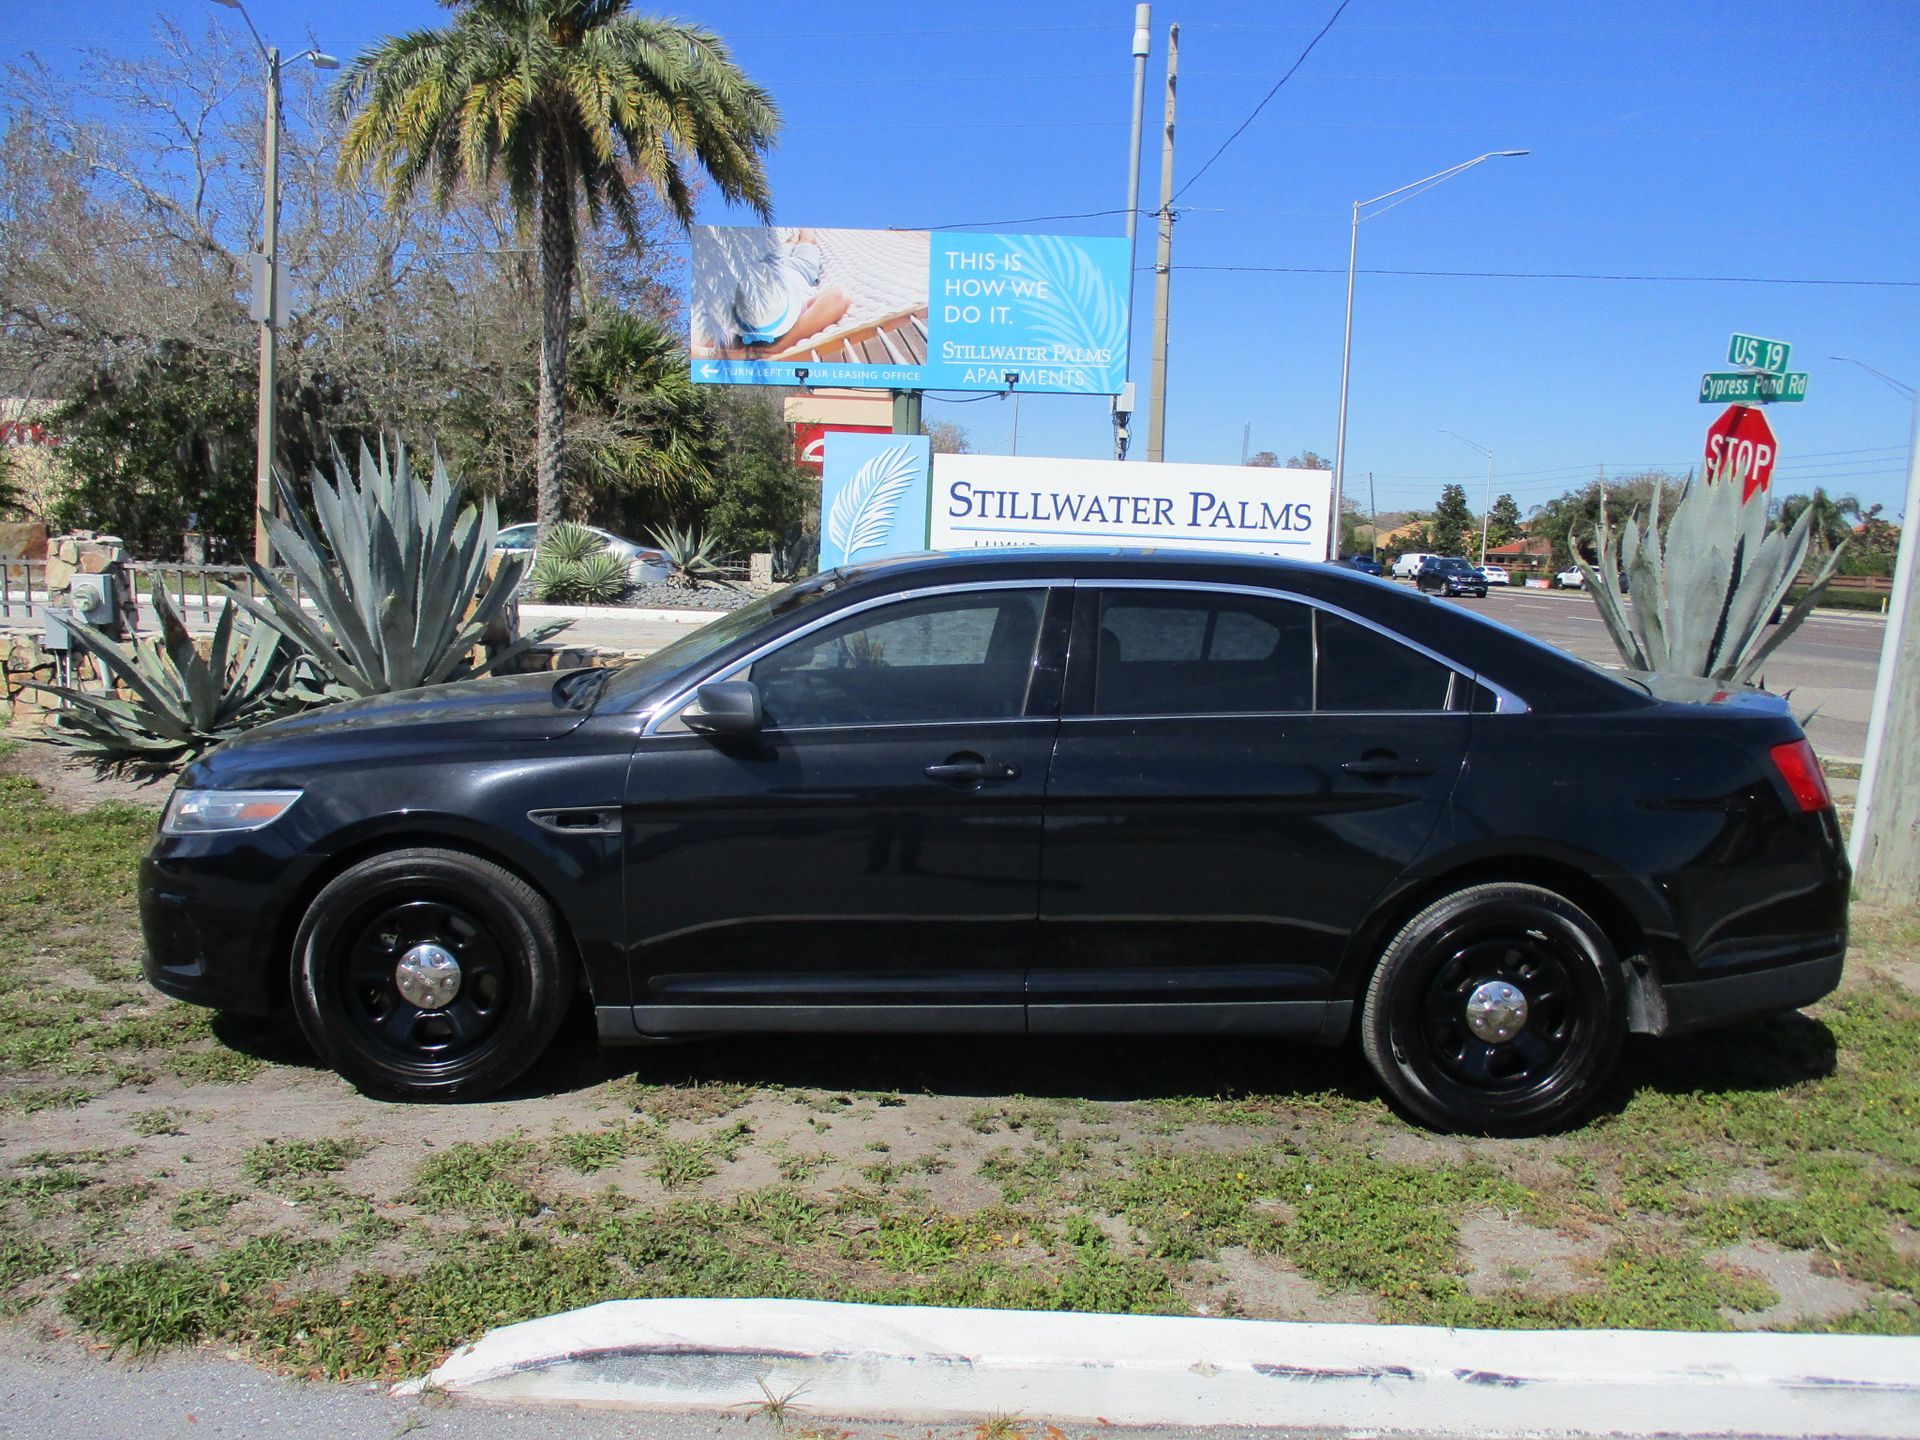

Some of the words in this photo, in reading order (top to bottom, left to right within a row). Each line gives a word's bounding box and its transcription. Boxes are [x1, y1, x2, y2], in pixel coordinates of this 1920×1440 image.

[944, 251, 996, 271] THIS
[1005, 253, 1021, 272] IS
[945, 279, 1006, 297] HOW
[1011, 281, 1048, 299] WE
[945, 305, 981, 323] DO
[990, 307, 1013, 325] IT.
[942, 341, 1048, 362] STILLWATER
[1053, 345, 1111, 363] PALMS
[1734, 336, 1758, 367] US
[1764, 343, 1783, 371] 19
[723, 367, 753, 376] TURN
[758, 369, 780, 377] LEFT
[832, 370, 878, 380] LEASING
[882, 371, 920, 381] OFFICE
[1701, 375, 1749, 401] Cypress
[1753, 374, 1784, 395] Pond
[1788, 374, 1807, 395] Rd
[1707, 433, 1772, 481] STOP
[949, 481, 1175, 526] STILLWATER
[1187, 491, 1312, 532] PALMS
